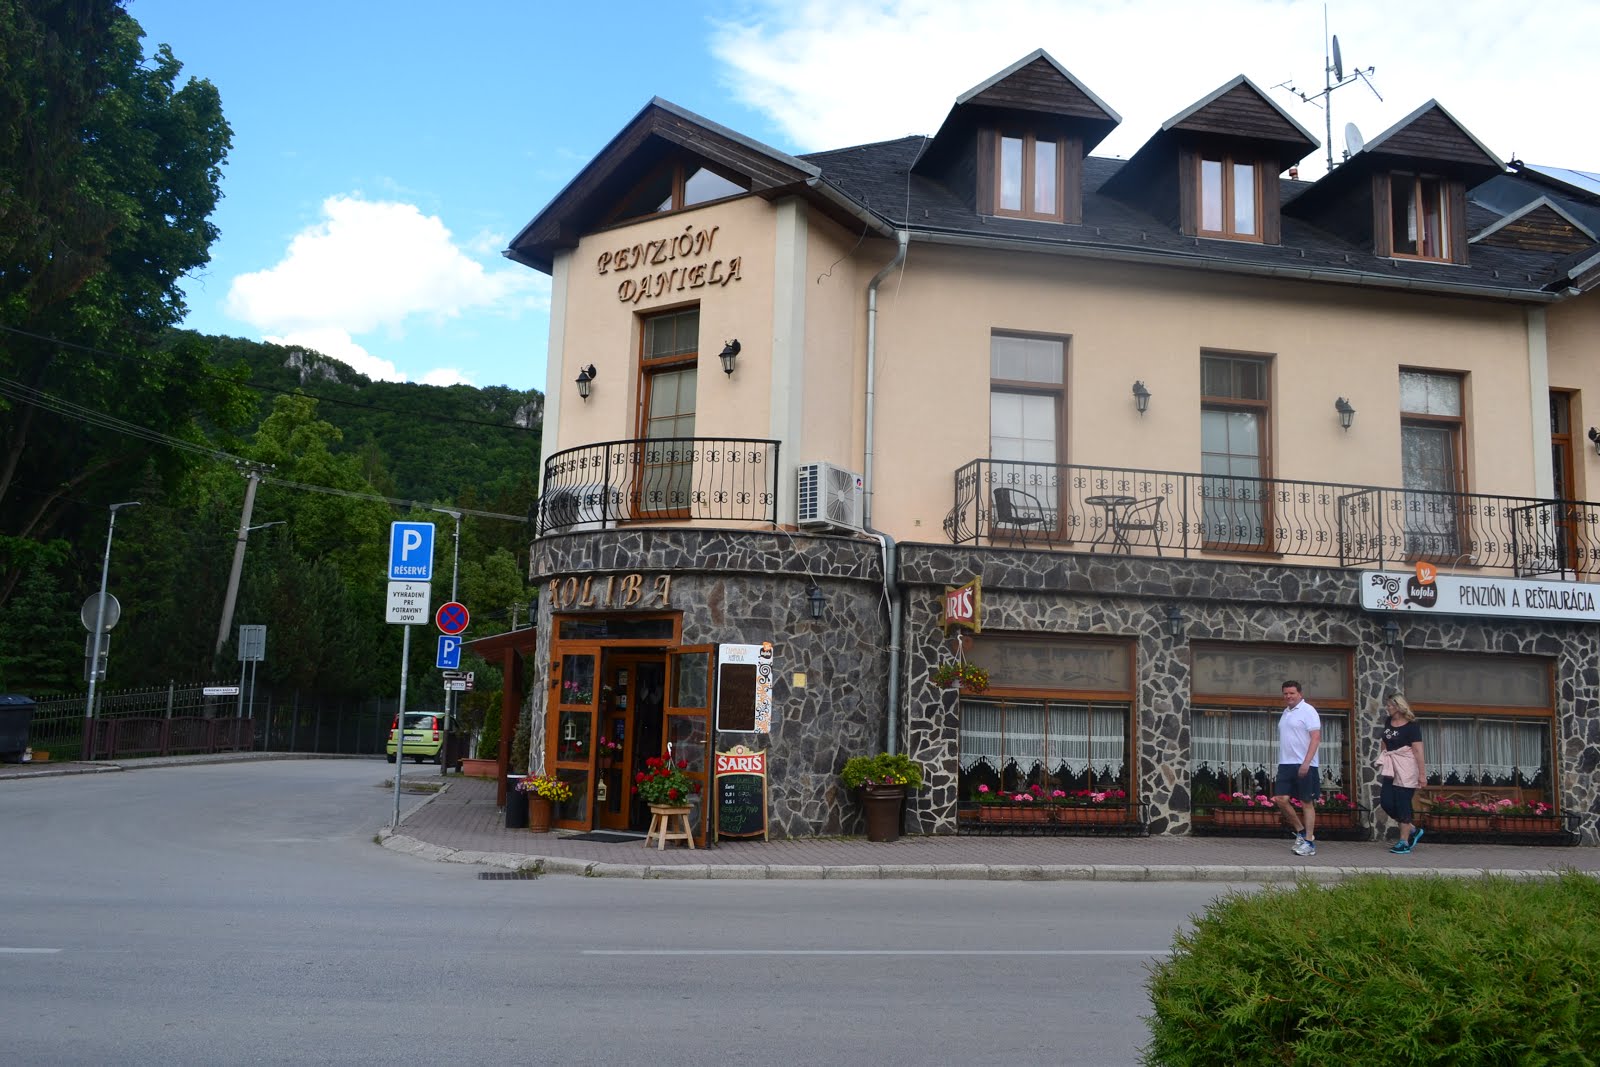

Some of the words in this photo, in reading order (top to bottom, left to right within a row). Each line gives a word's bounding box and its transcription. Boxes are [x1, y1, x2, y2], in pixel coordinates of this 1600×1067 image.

[597, 224, 720, 275] PENZIÓN
[617, 256, 742, 304] DANIELA
[402, 529, 423, 562] P
[393, 565, 427, 576] RÉSERVÉ
[548, 573, 672, 609] KOLIBA
[1410, 585, 1434, 600] kofola
[1459, 584, 1506, 608] PENZIÓN
[1512, 589, 1520, 608] A
[1525, 586, 1595, 612] REŠTAURÁCIA
[391, 606, 423, 614] POTRAVINY
[443, 639, 455, 658] P
[717, 755, 763, 772] ŠARIŠ
